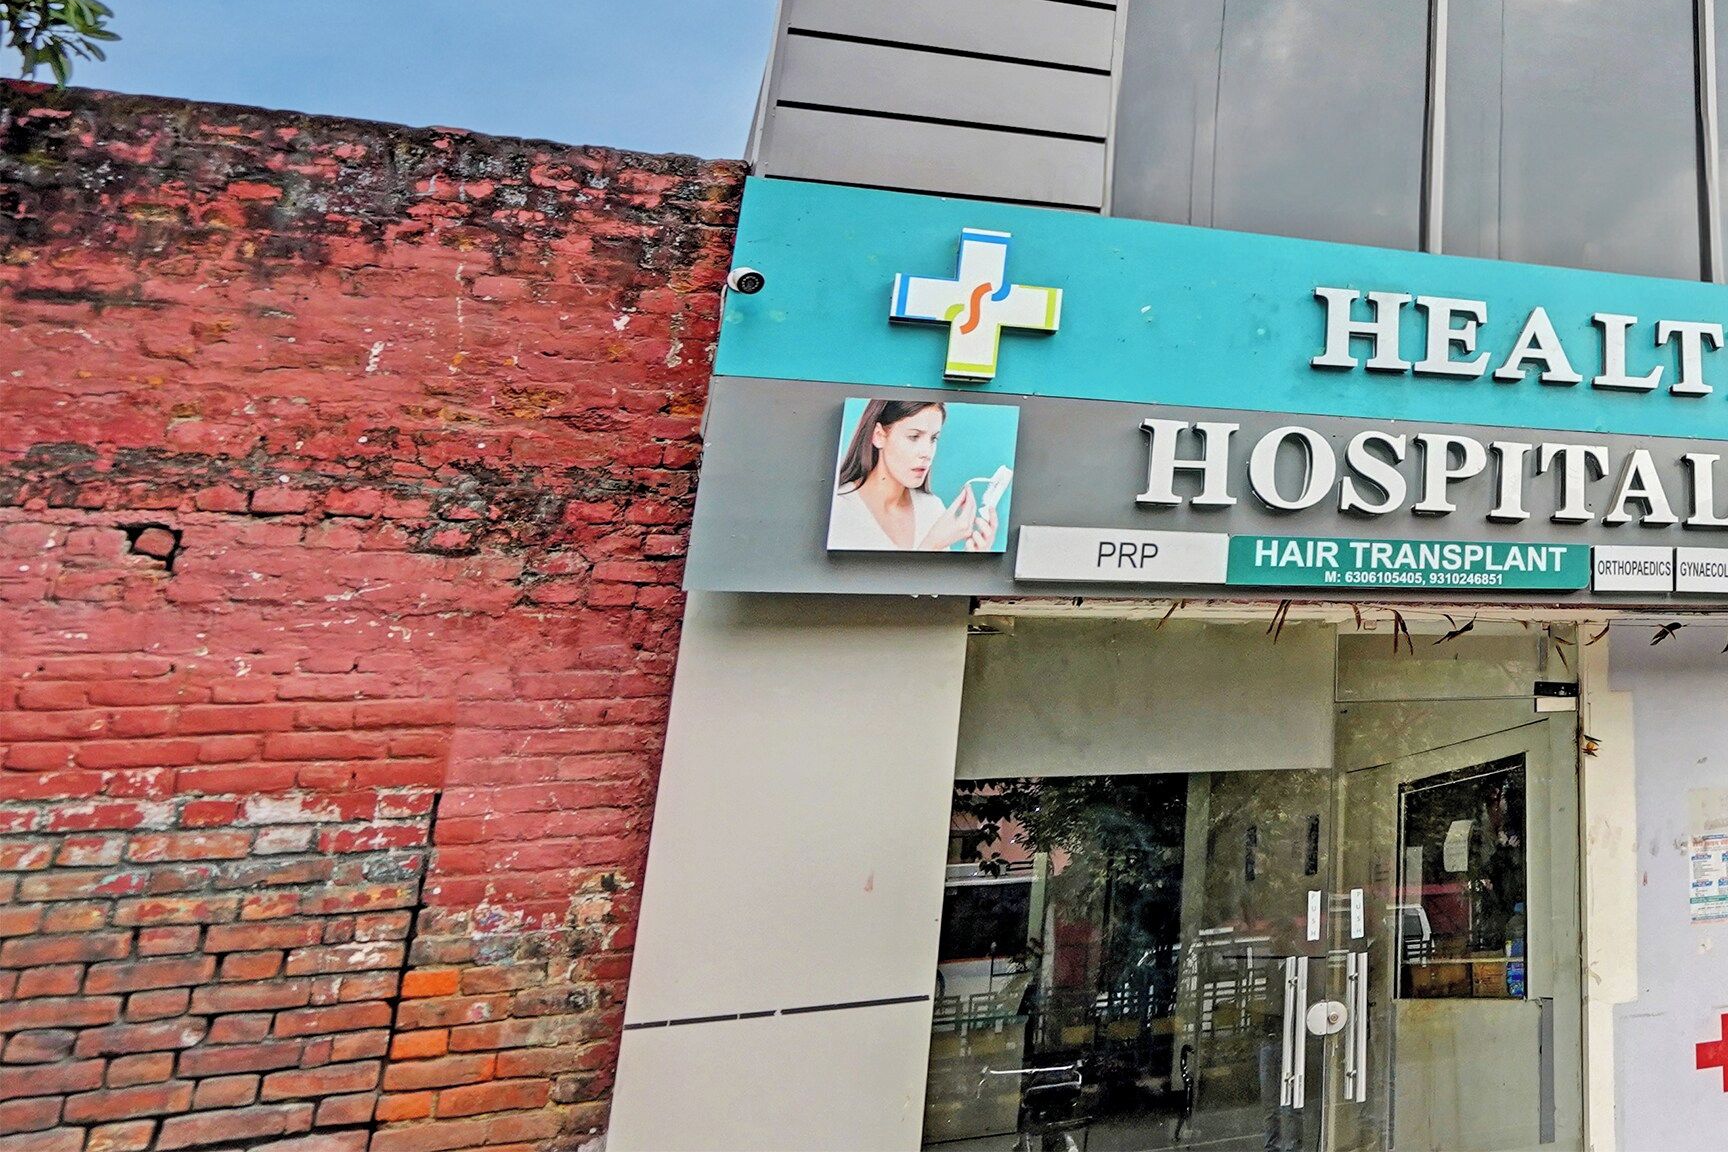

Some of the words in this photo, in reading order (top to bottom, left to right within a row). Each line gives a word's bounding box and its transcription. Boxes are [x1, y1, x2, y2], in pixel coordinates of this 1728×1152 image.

[1097, 541, 1159, 569] PRP
[1254, 539, 1339, 568] HAIR
[1349, 541, 1567, 573] TRANSPLANT
[1324, 571, 1341, 584] M:
[1429, 572, 1503, 586] 9310246851
[1597, 560, 1672, 577] ORTHOPAEDICS
